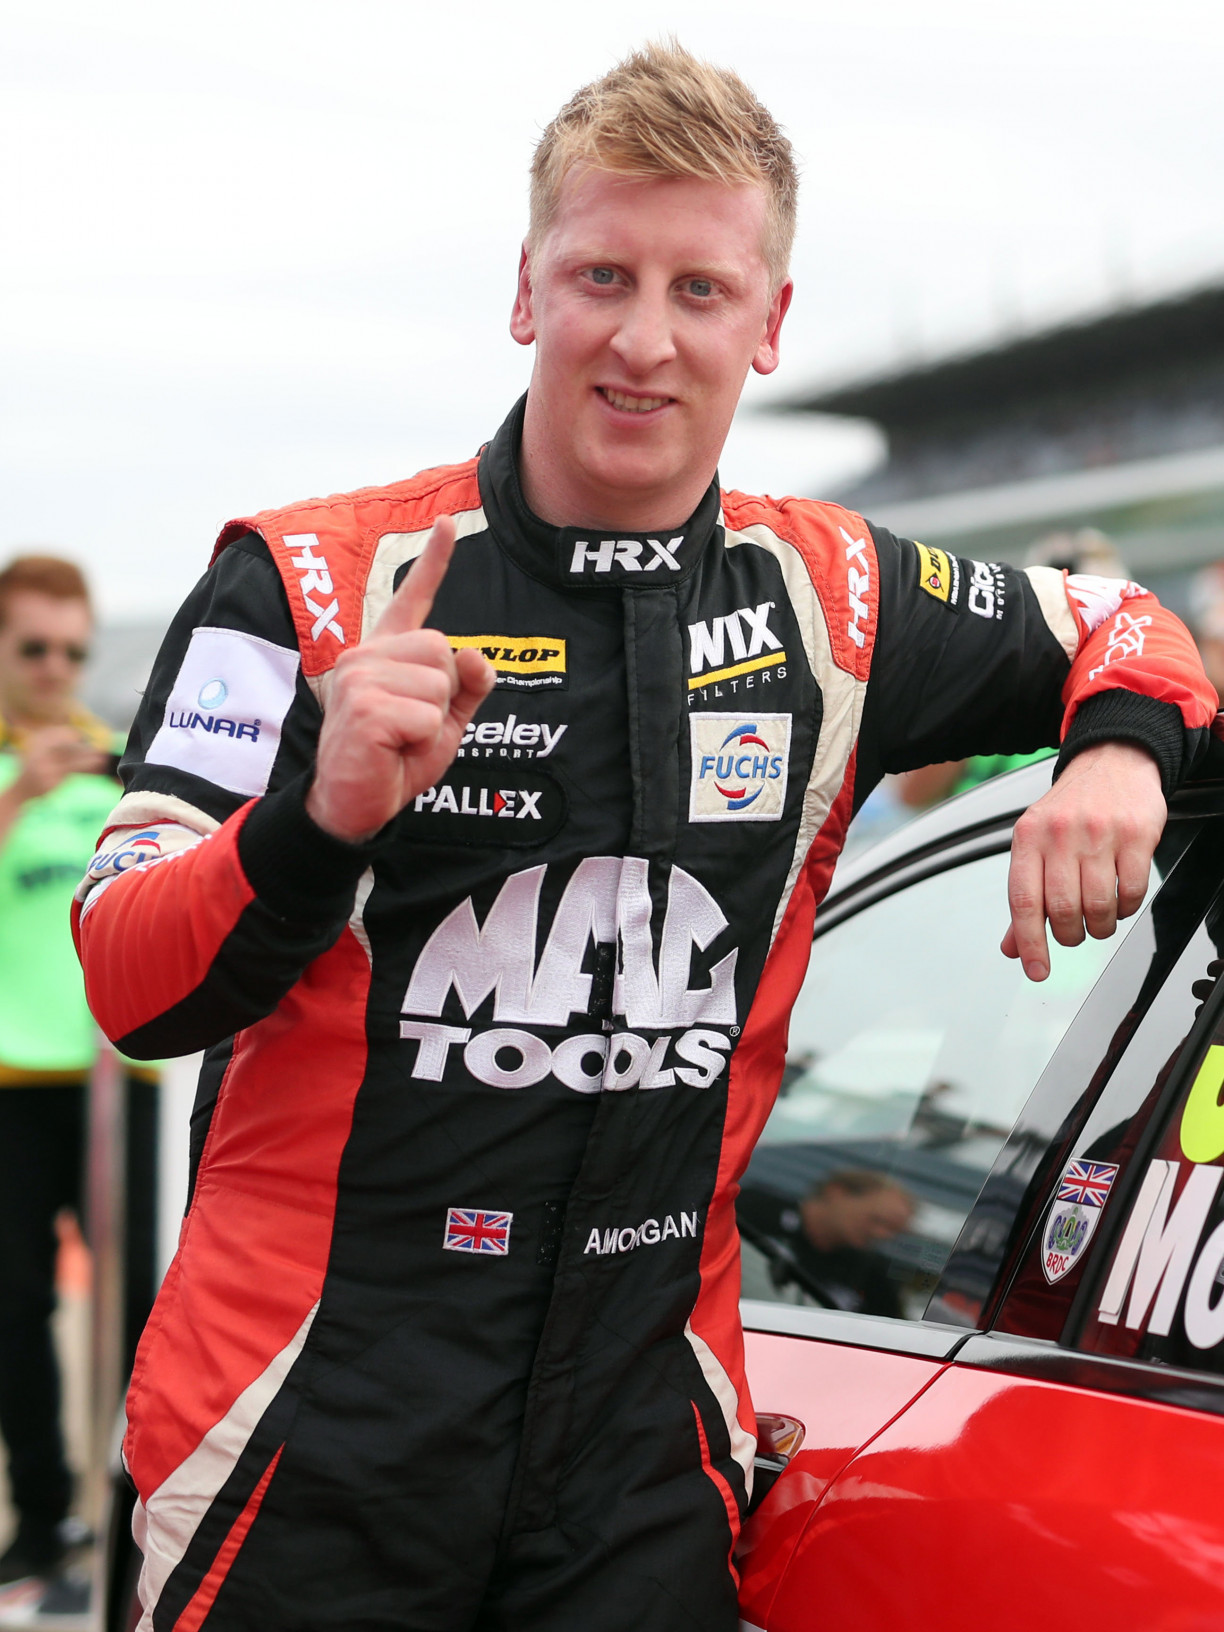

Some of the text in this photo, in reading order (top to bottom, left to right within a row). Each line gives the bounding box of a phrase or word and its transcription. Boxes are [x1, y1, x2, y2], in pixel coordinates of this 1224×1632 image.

[569, 536, 684, 573] HRX
[283, 533, 345, 645] HRX
[838, 526, 871, 649] HRX
[688, 602, 783, 674] WIX
[687, 667, 787, 706] FILTERS
[169, 711, 261, 743] LUNAR
[459, 714, 568, 758] celey
[699, 755, 783, 779] FUCHS
[413, 785, 543, 820] PALLEX
[400, 856, 739, 1028] MAC
[399, 1020, 732, 1094] TOOLS
[1045, 1252, 1069, 1275] BRDC
